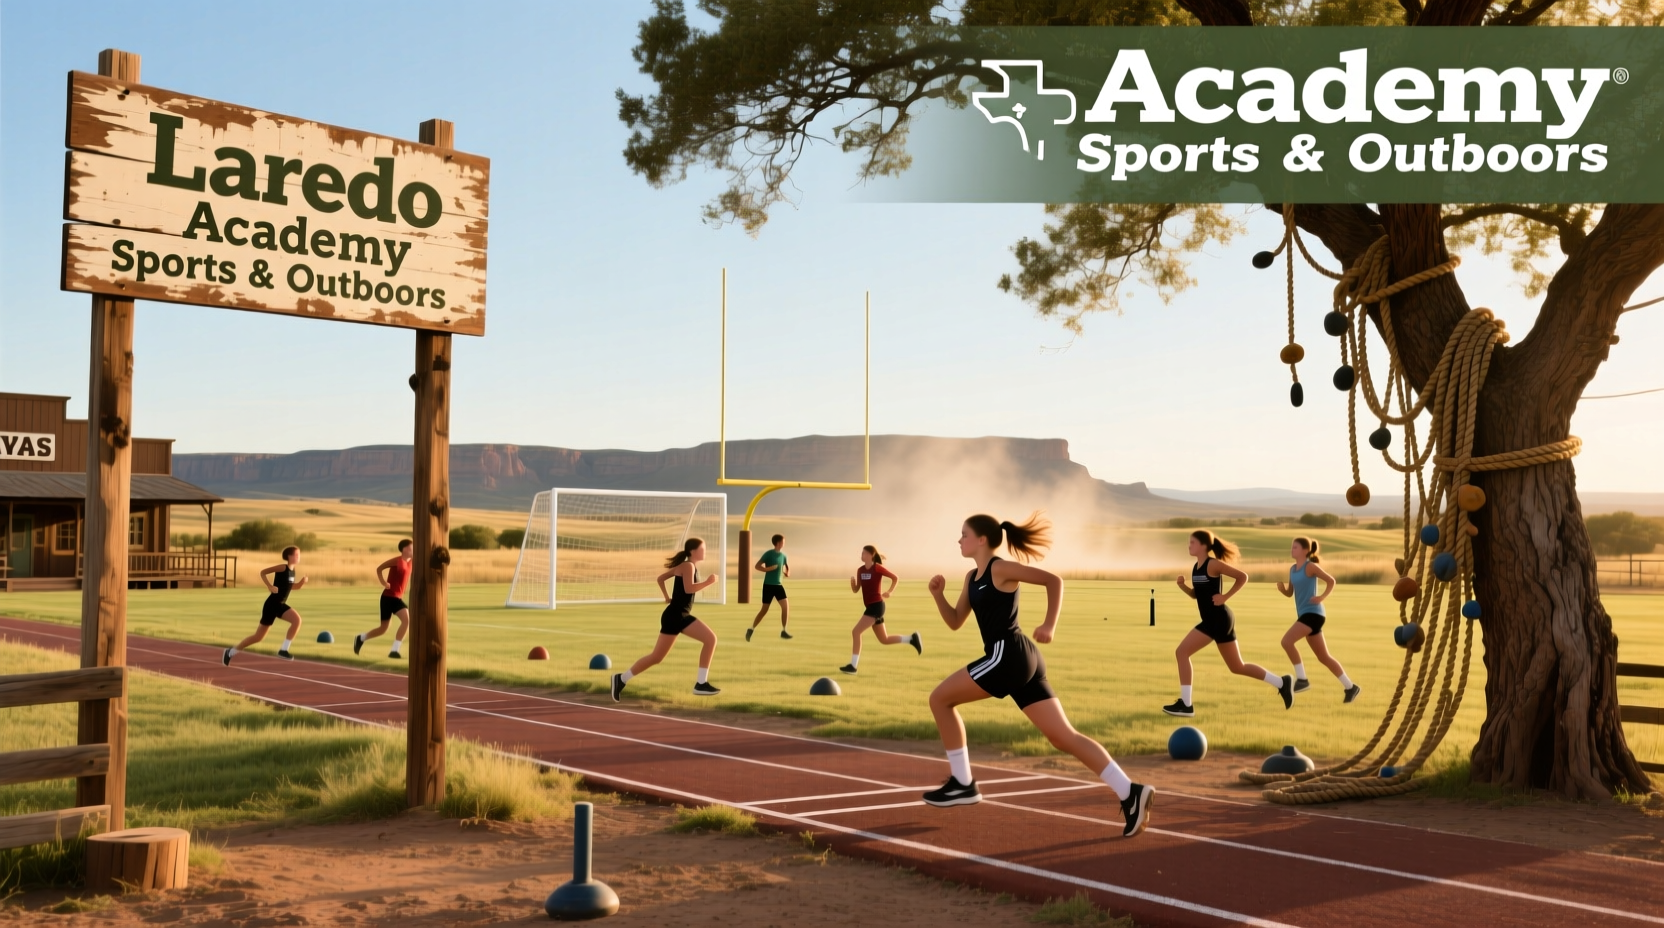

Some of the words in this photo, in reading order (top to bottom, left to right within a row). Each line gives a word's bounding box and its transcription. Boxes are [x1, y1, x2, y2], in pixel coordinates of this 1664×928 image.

[146, 111, 443, 229] Laredo
[111, 239, 237, 284] Sports
[248, 259, 275, 290] &
[286, 263, 446, 310] Outboors
[182, 201, 412, 277] Academy
[0, 435, 52, 457] YAS
